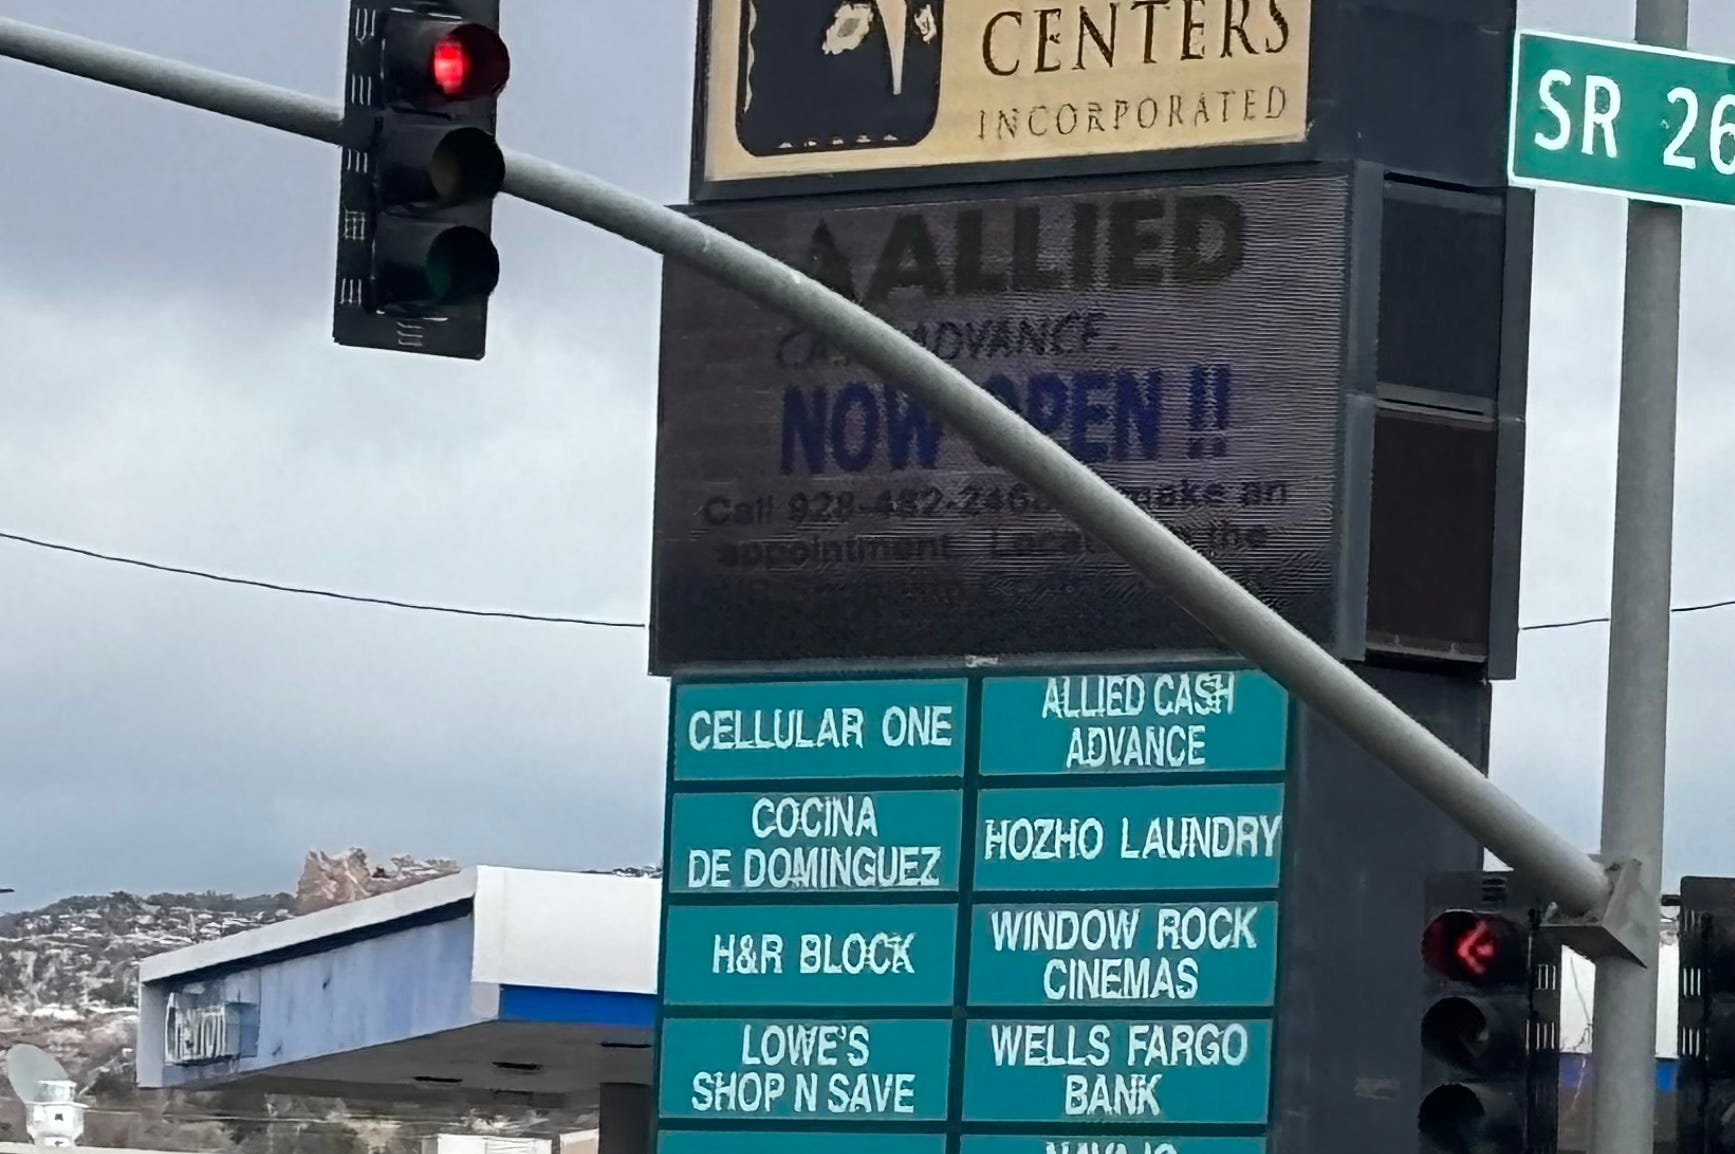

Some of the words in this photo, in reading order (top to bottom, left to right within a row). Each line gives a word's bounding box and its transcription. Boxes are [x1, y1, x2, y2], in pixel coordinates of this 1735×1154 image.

[981, 0, 1289, 77] CENTERS
[978, 86, 1287, 141] INCORPORATED
[1535, 69, 1621, 158] SR
[864, 194, 1247, 303] ALLIED
[780, 382, 943, 475] NOW
[1043, 675, 1145, 718] ALLIED
[1154, 672, 1234, 716] CASH
[690, 708, 863, 750] CELLULAR
[883, 706, 951, 746] ONE
[1067, 726, 1205, 768] ADVANCE
[753, 796, 877, 838] COCINA
[985, 818, 1103, 860] HOZHO
[1121, 815, 1282, 858] LAUNDRY
[688, 850, 731, 887] DE
[744, 846, 940, 888] DOMINGUEZ
[992, 909, 1140, 950] WINDOW
[1157, 907, 1257, 950] ROCK
[713, 935, 783, 973] H&R
[800, 933, 914, 974] BLOCK
[1044, 957, 1198, 999] CINEMAS
[742, 1025, 868, 1066] LOWE'S
[992, 1025, 1110, 1066] WELLS
[1128, 1023, 1247, 1066] FARGO
[692, 1072, 784, 1111] SHOP
[795, 1073, 817, 1111] N
[828, 1073, 914, 1113] SAVE
[1066, 1074, 1162, 1115] BANK
